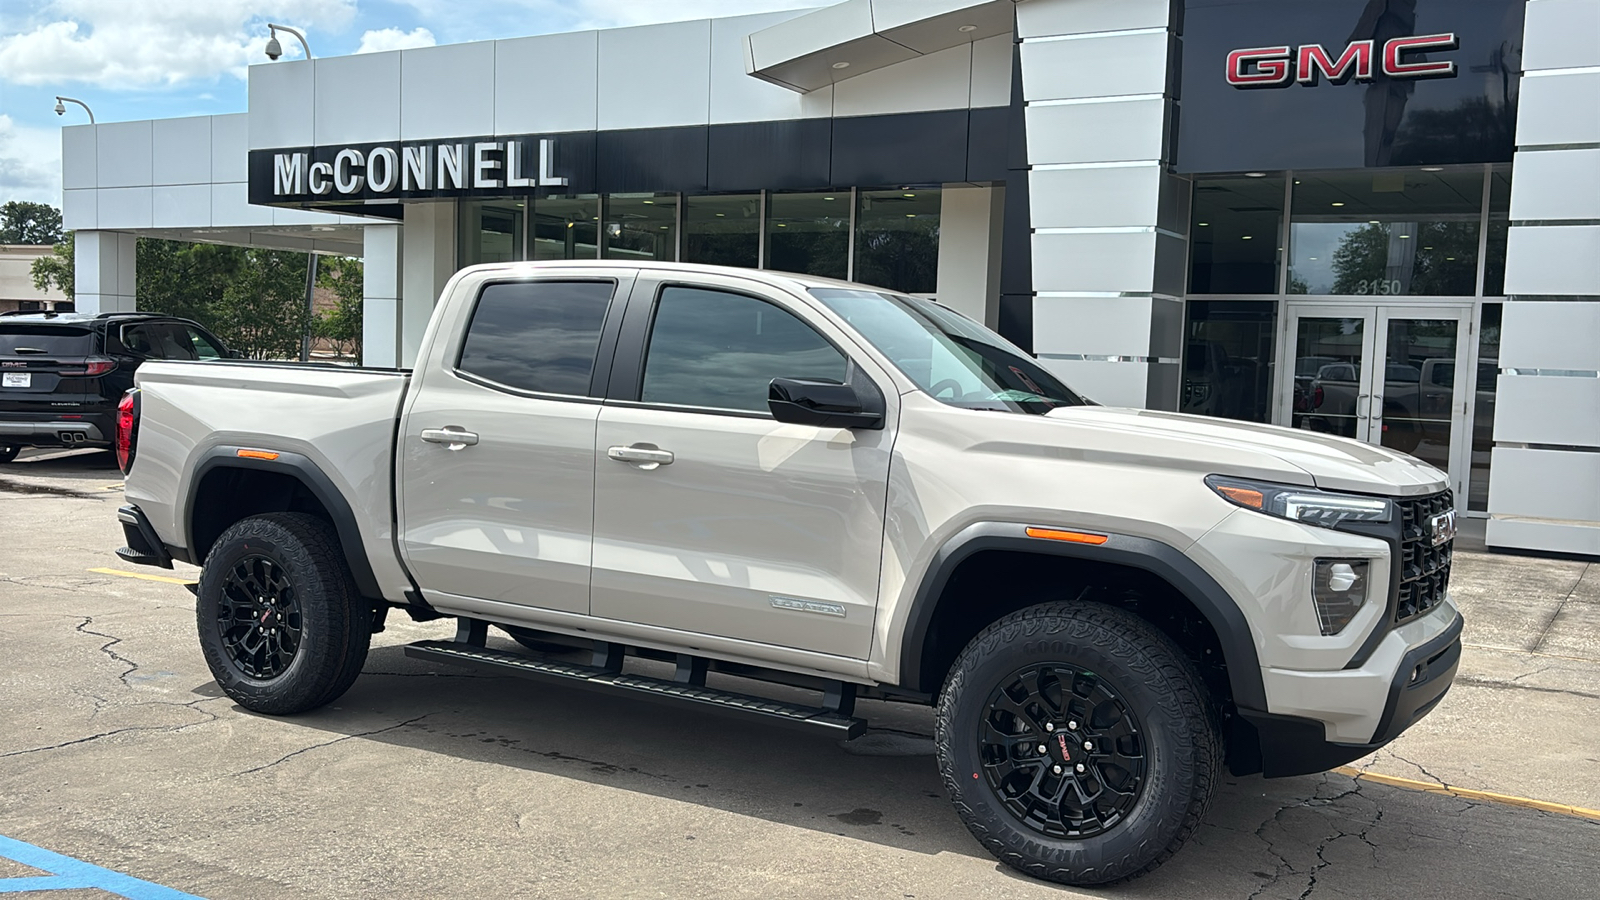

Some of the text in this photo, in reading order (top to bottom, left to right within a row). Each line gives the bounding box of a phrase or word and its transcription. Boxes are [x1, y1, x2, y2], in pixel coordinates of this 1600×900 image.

[1226, 32, 1455, 86] GMC
[273, 139, 568, 196] McCONNELL
[1357, 279, 1401, 295] 3150
